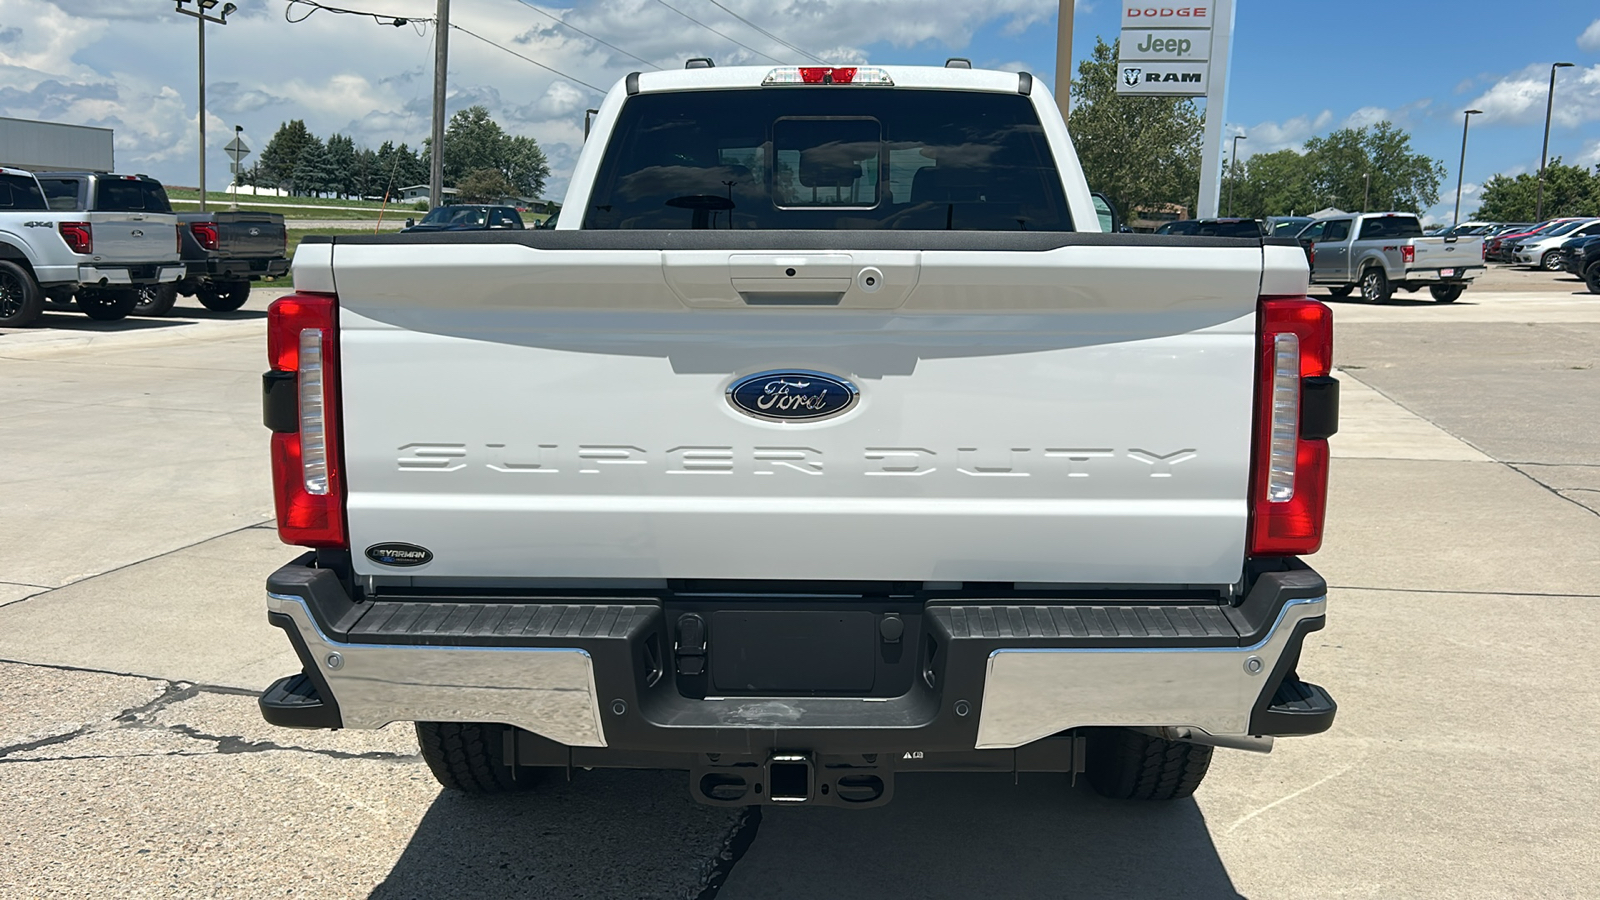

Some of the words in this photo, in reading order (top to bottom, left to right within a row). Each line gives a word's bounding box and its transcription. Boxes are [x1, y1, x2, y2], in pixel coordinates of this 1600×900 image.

[1127, 8, 1207, 17] DODGE
[1137, 34, 1191, 56] Jeep
[1145, 73, 1202, 82] RAM
[757, 380, 828, 411] Ford
[397, 443, 824, 475] SUPER
[865, 447, 1198, 477] DUTY
[372, 549, 426, 559] DEYARMAN
